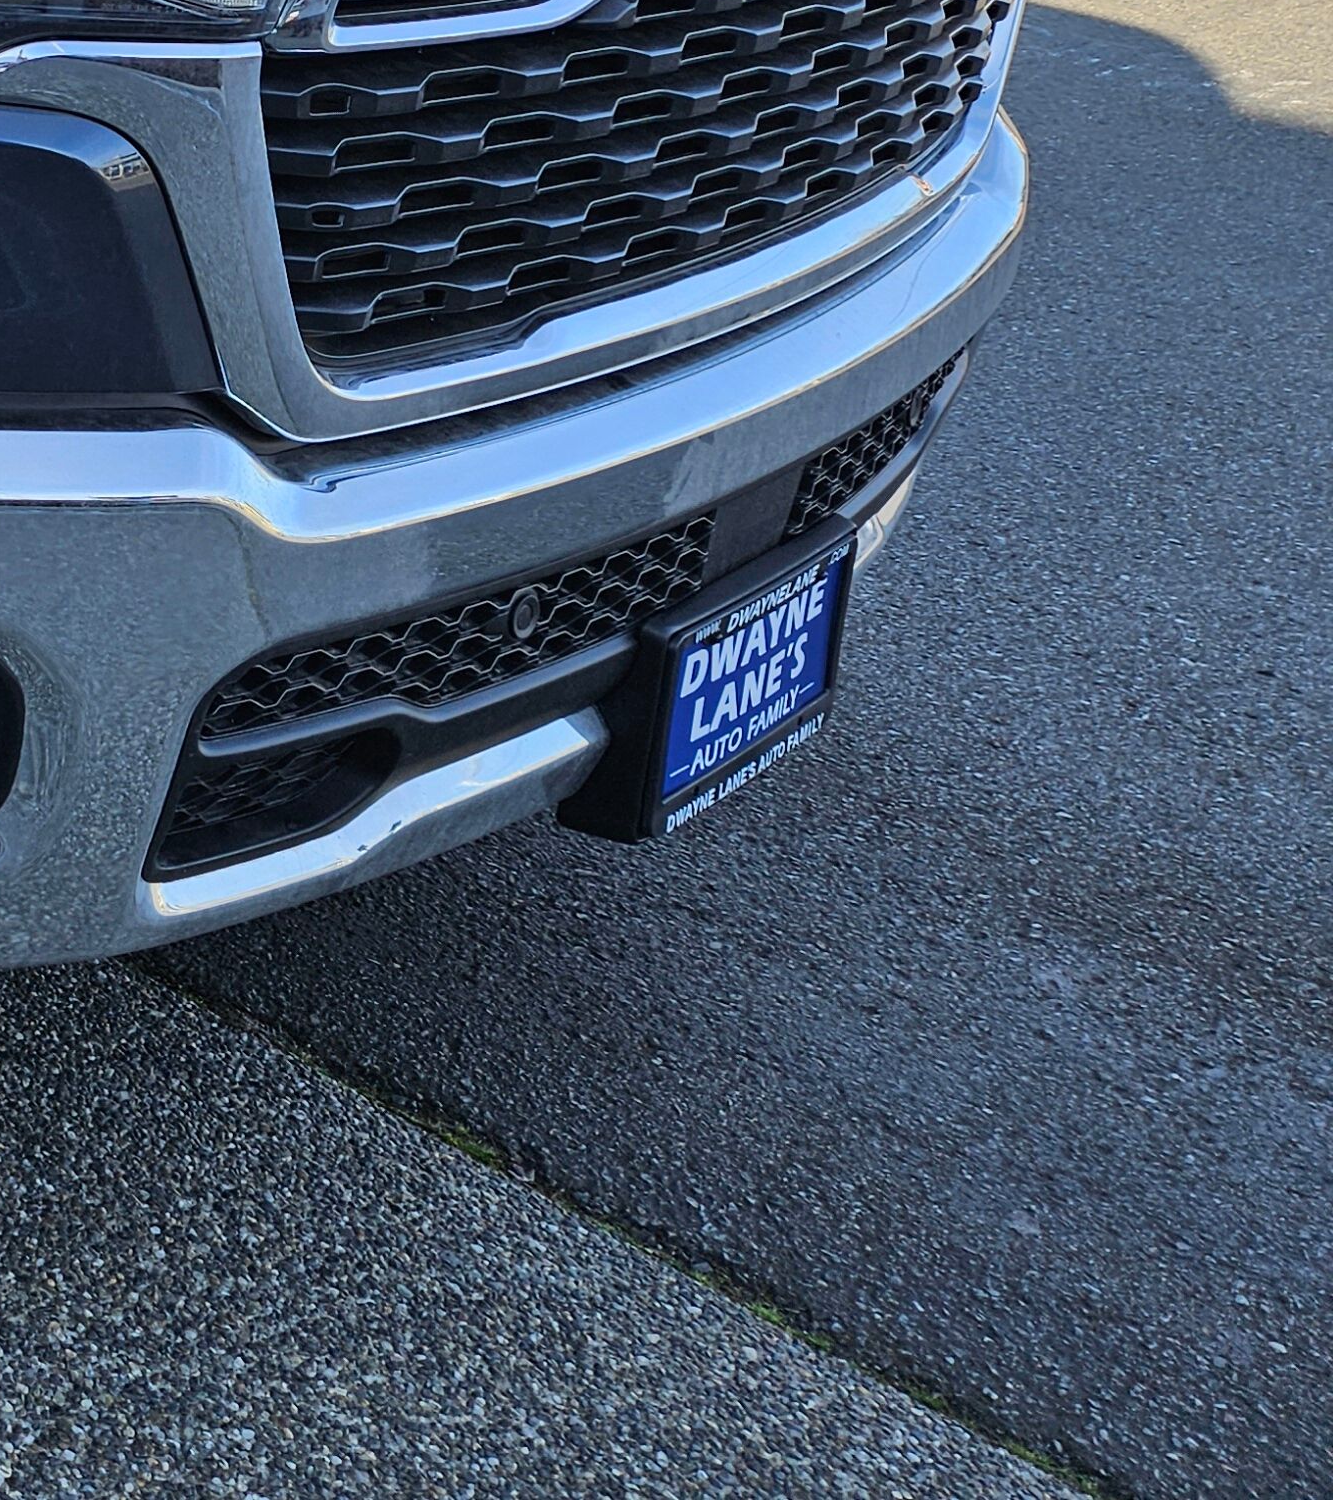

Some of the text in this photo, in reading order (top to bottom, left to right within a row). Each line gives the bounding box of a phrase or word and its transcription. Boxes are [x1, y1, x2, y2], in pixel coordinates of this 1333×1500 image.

[680, 577, 828, 699] DWAYNE
[690, 631, 808, 743] LANE'S
[666, 787, 716, 834] DWAYNE
[757, 741, 786, 773] AUTO
[786, 712, 825, 752] FAMILY
[689, 684, 800, 776] AUTO FAMILY
